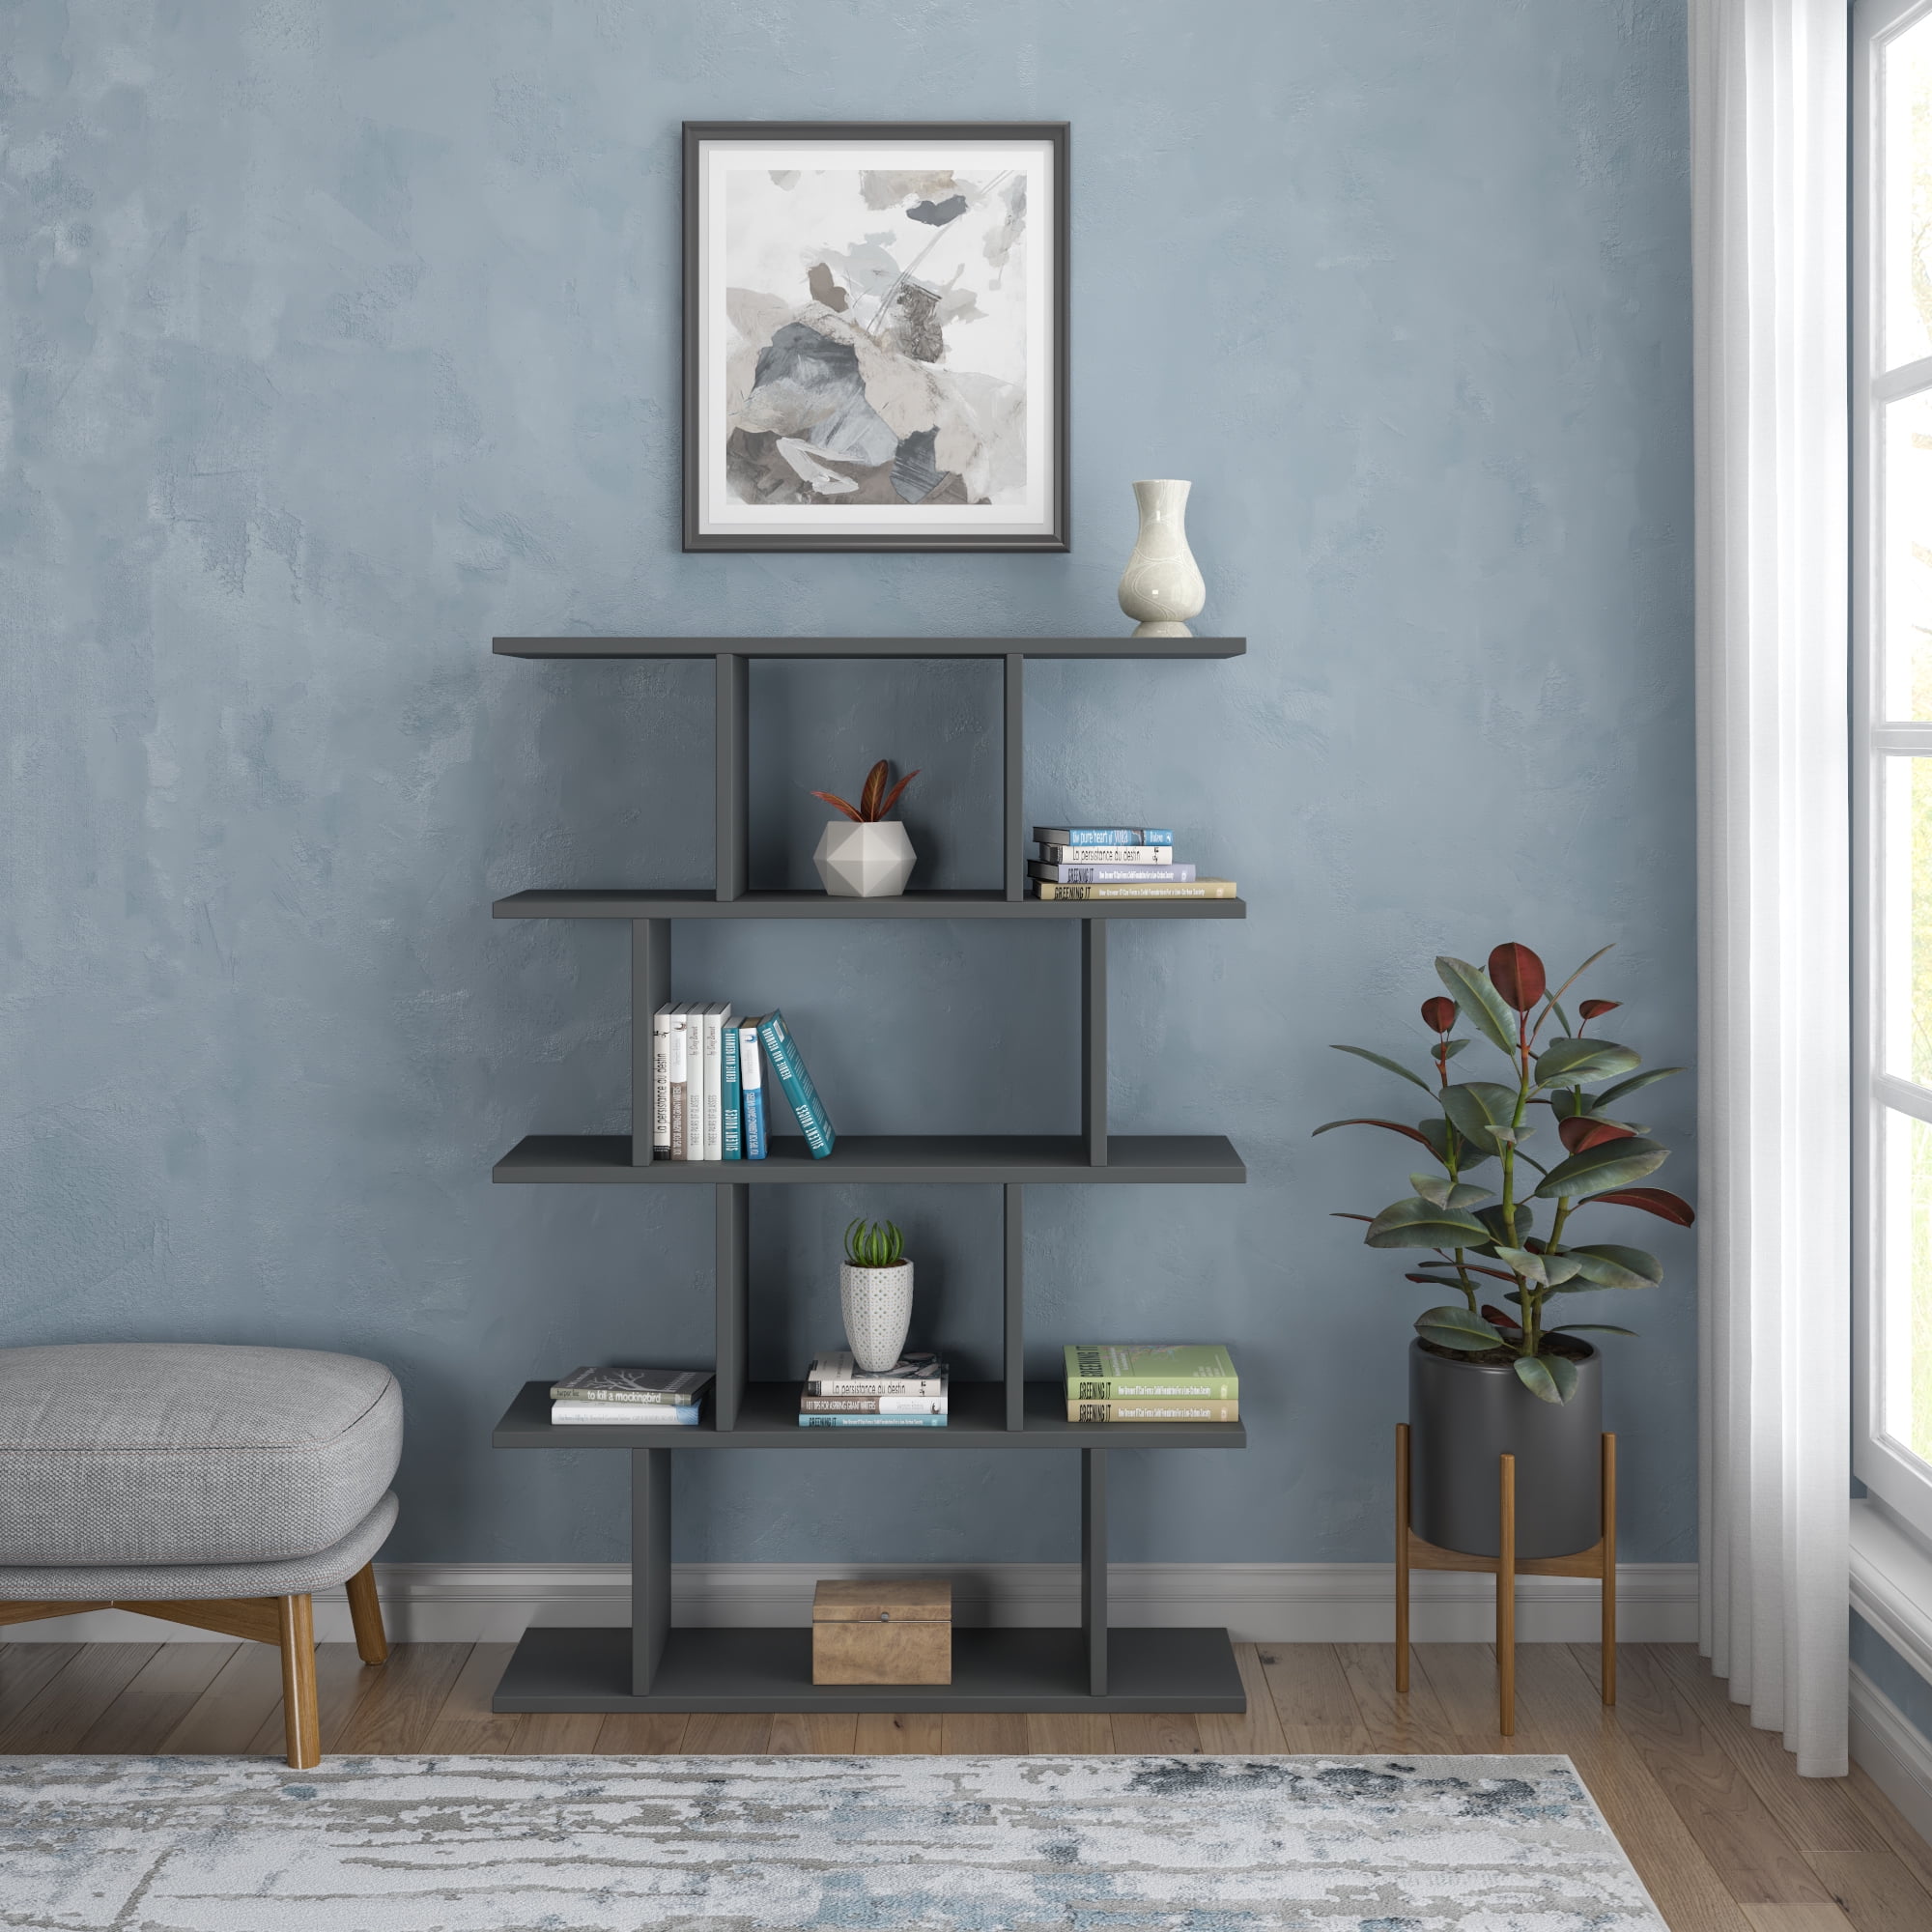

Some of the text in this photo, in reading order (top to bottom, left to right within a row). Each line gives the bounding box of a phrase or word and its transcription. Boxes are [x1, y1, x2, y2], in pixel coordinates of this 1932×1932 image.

[1080, 831, 1094, 845] pure
[1094, 830, 1108, 843] heart
[1073, 847, 1080, 860] La
[1081, 847, 1113, 864] persistance
[1124, 846, 1140, 861] destin
[1068, 868, 1089, 883] GREENING
[1055, 887, 1092, 899] GREENING IT
[654, 1053, 667, 1073] destin
[655, 1087, 668, 1123] persistance
[795, 1104, 814, 1127] VOICES
[724, 1109, 738, 1151] SILENT VOICES
[805, 1126, 825, 1150] SILENT
[1077, 1352, 1103, 1378] GREENING
[833, 1382, 839, 1394] La
[841, 1381, 875, 1396] persistance
[887, 1381, 905, 1394] destin
[1079, 1382, 1105, 1399] GREENING
[1105, 1382, 1111, 1399] IT
[587, 1391, 595, 1400] to
[597, 1390, 608, 1401] kill
[615, 1391, 661, 1405] mockingbird
[1079, 1405, 1105, 1422] GREENING
[1105, 1405, 1111, 1422] IT
